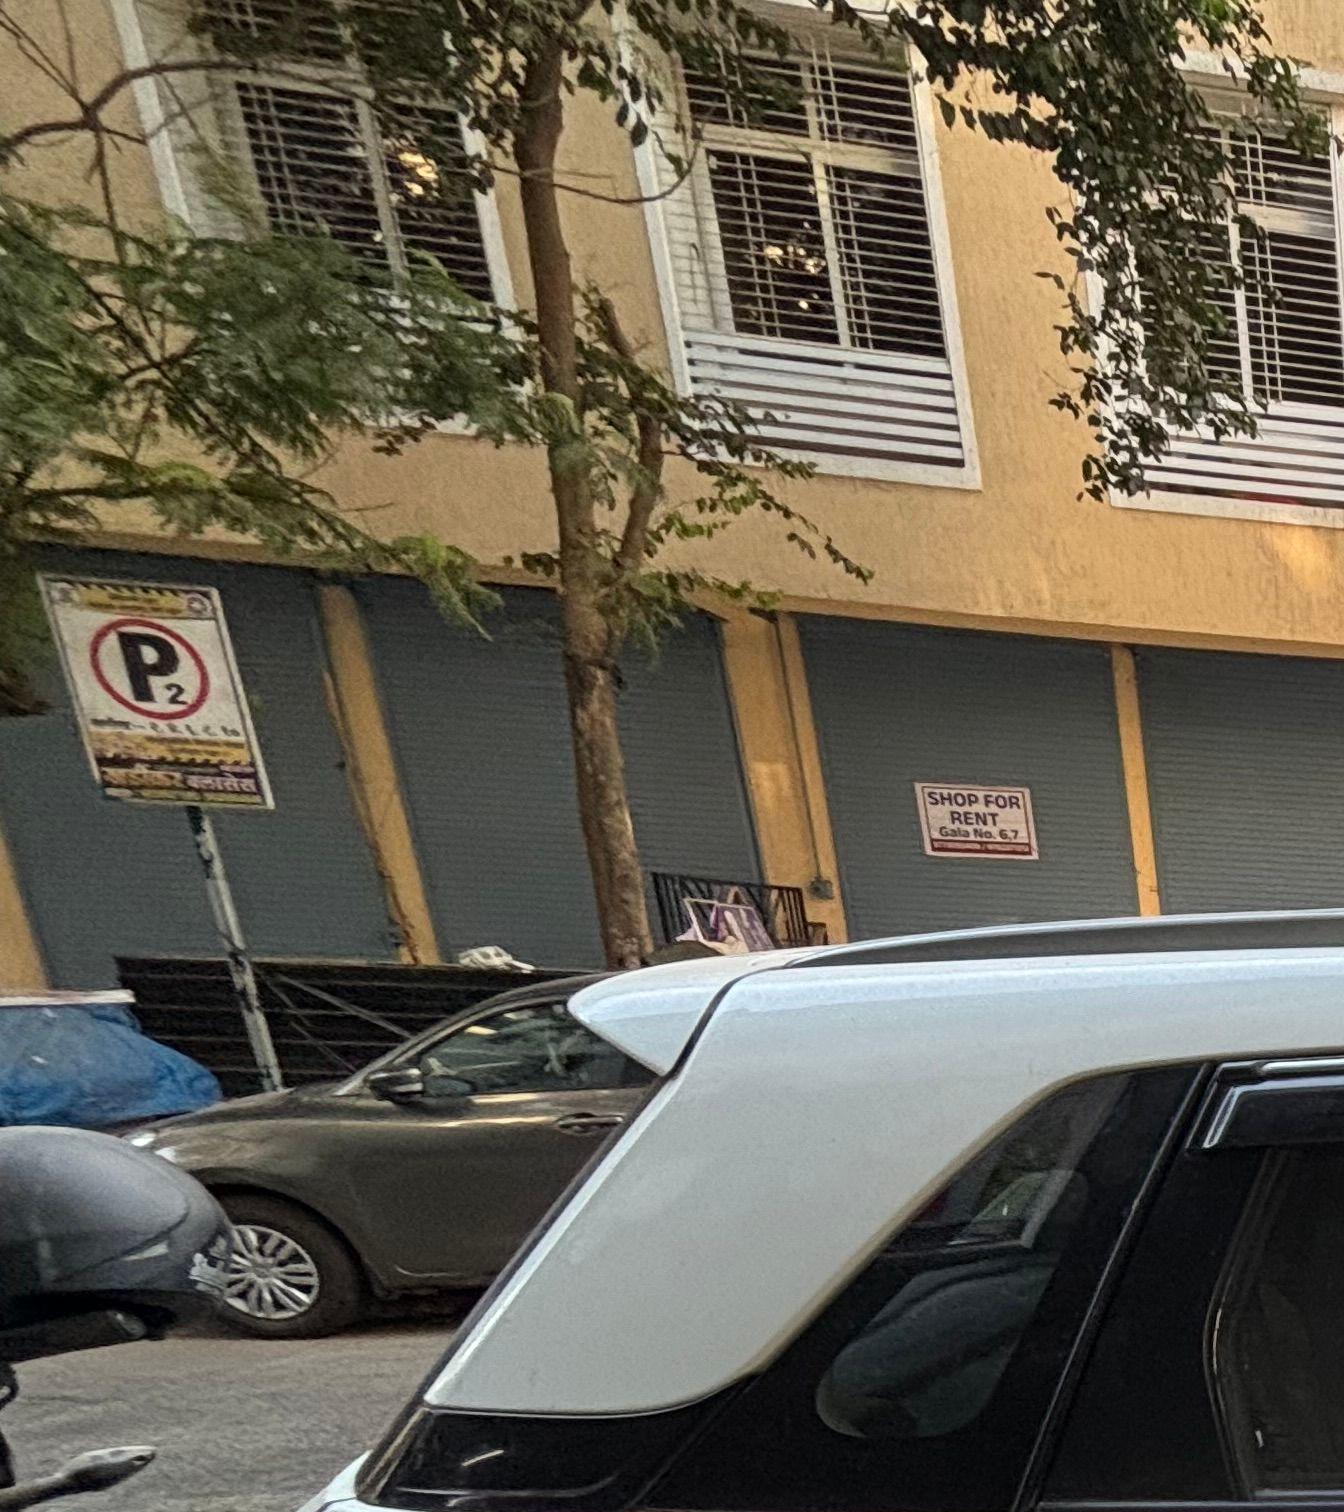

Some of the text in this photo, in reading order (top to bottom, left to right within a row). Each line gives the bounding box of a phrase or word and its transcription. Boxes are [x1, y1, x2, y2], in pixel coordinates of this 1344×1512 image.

[927, 791, 1022, 810] SHOP FOR
[950, 810, 999, 827] RENT
[939, 826, 970, 838] Gala
[973, 828, 996, 840] No.
